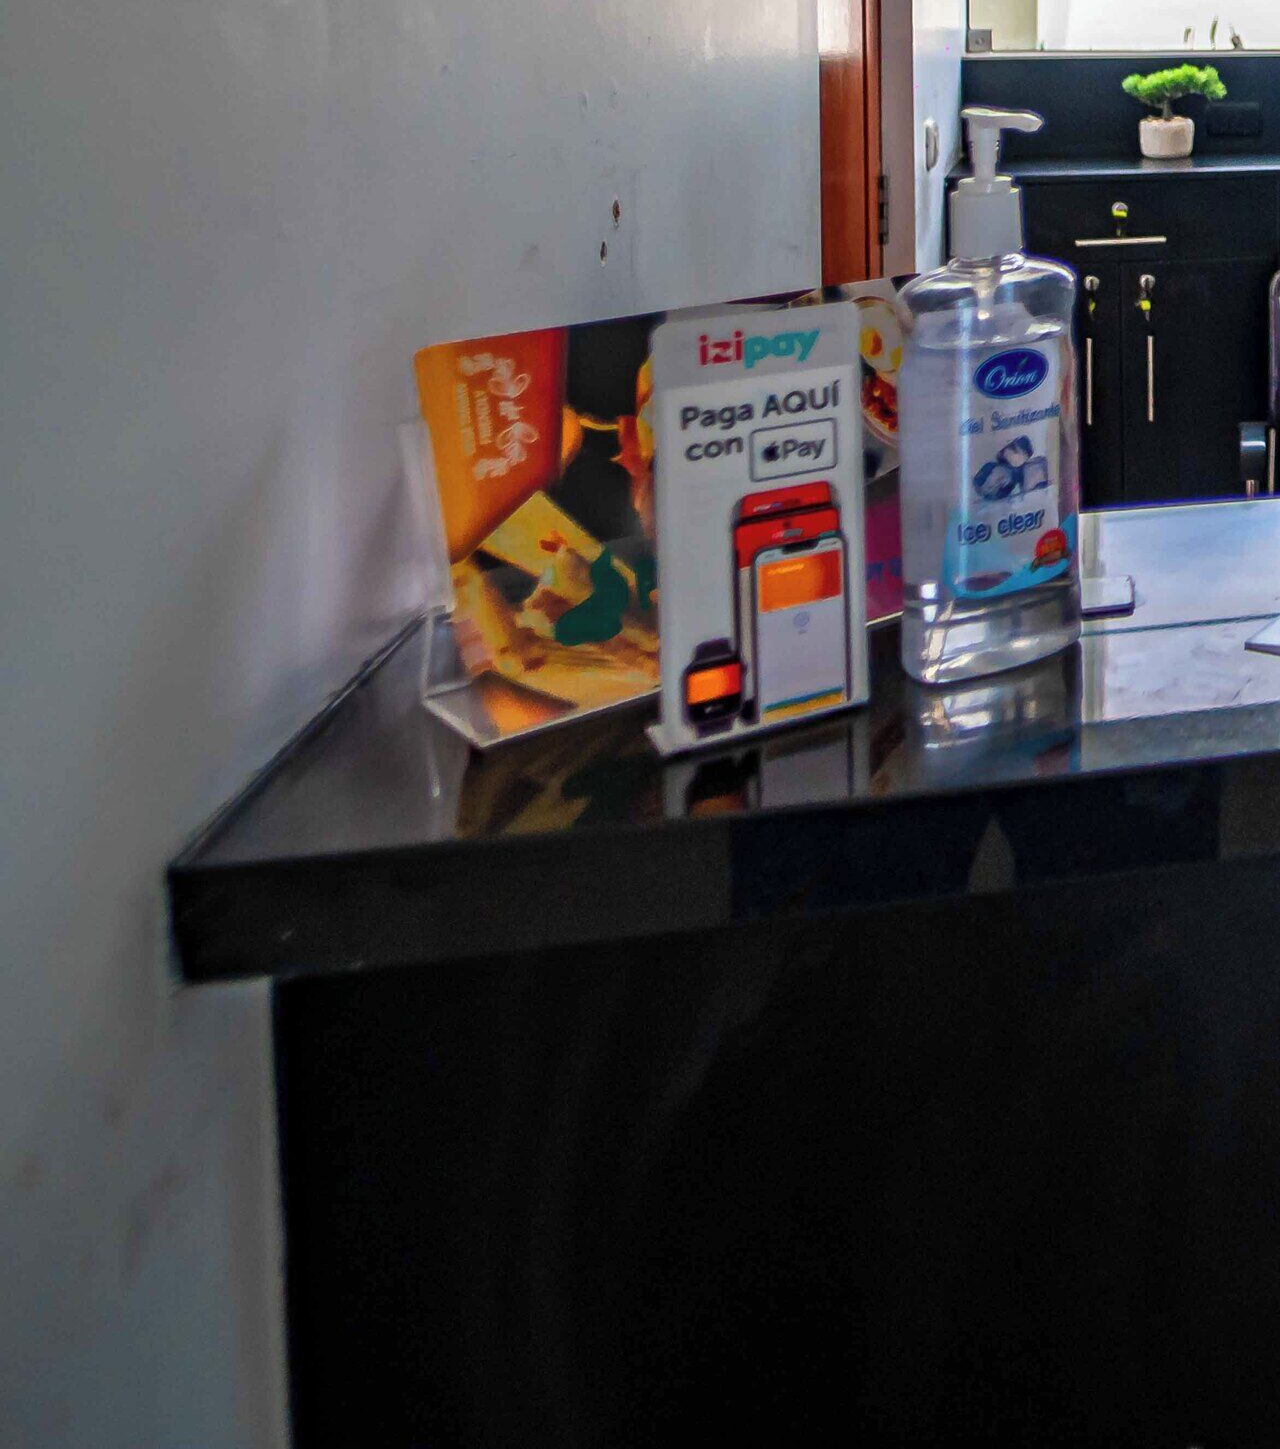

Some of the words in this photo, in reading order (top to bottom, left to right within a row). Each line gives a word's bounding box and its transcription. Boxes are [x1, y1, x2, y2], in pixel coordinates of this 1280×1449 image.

[698, 327, 821, 370] izipay
[680, 401, 754, 430] Paga
[762, 379, 841, 418] AQUÍ
[684, 435, 744, 462] con
[781, 437, 827, 466] Pay
[957, 522, 991, 545] Ice
[997, 509, 1045, 538] clear
